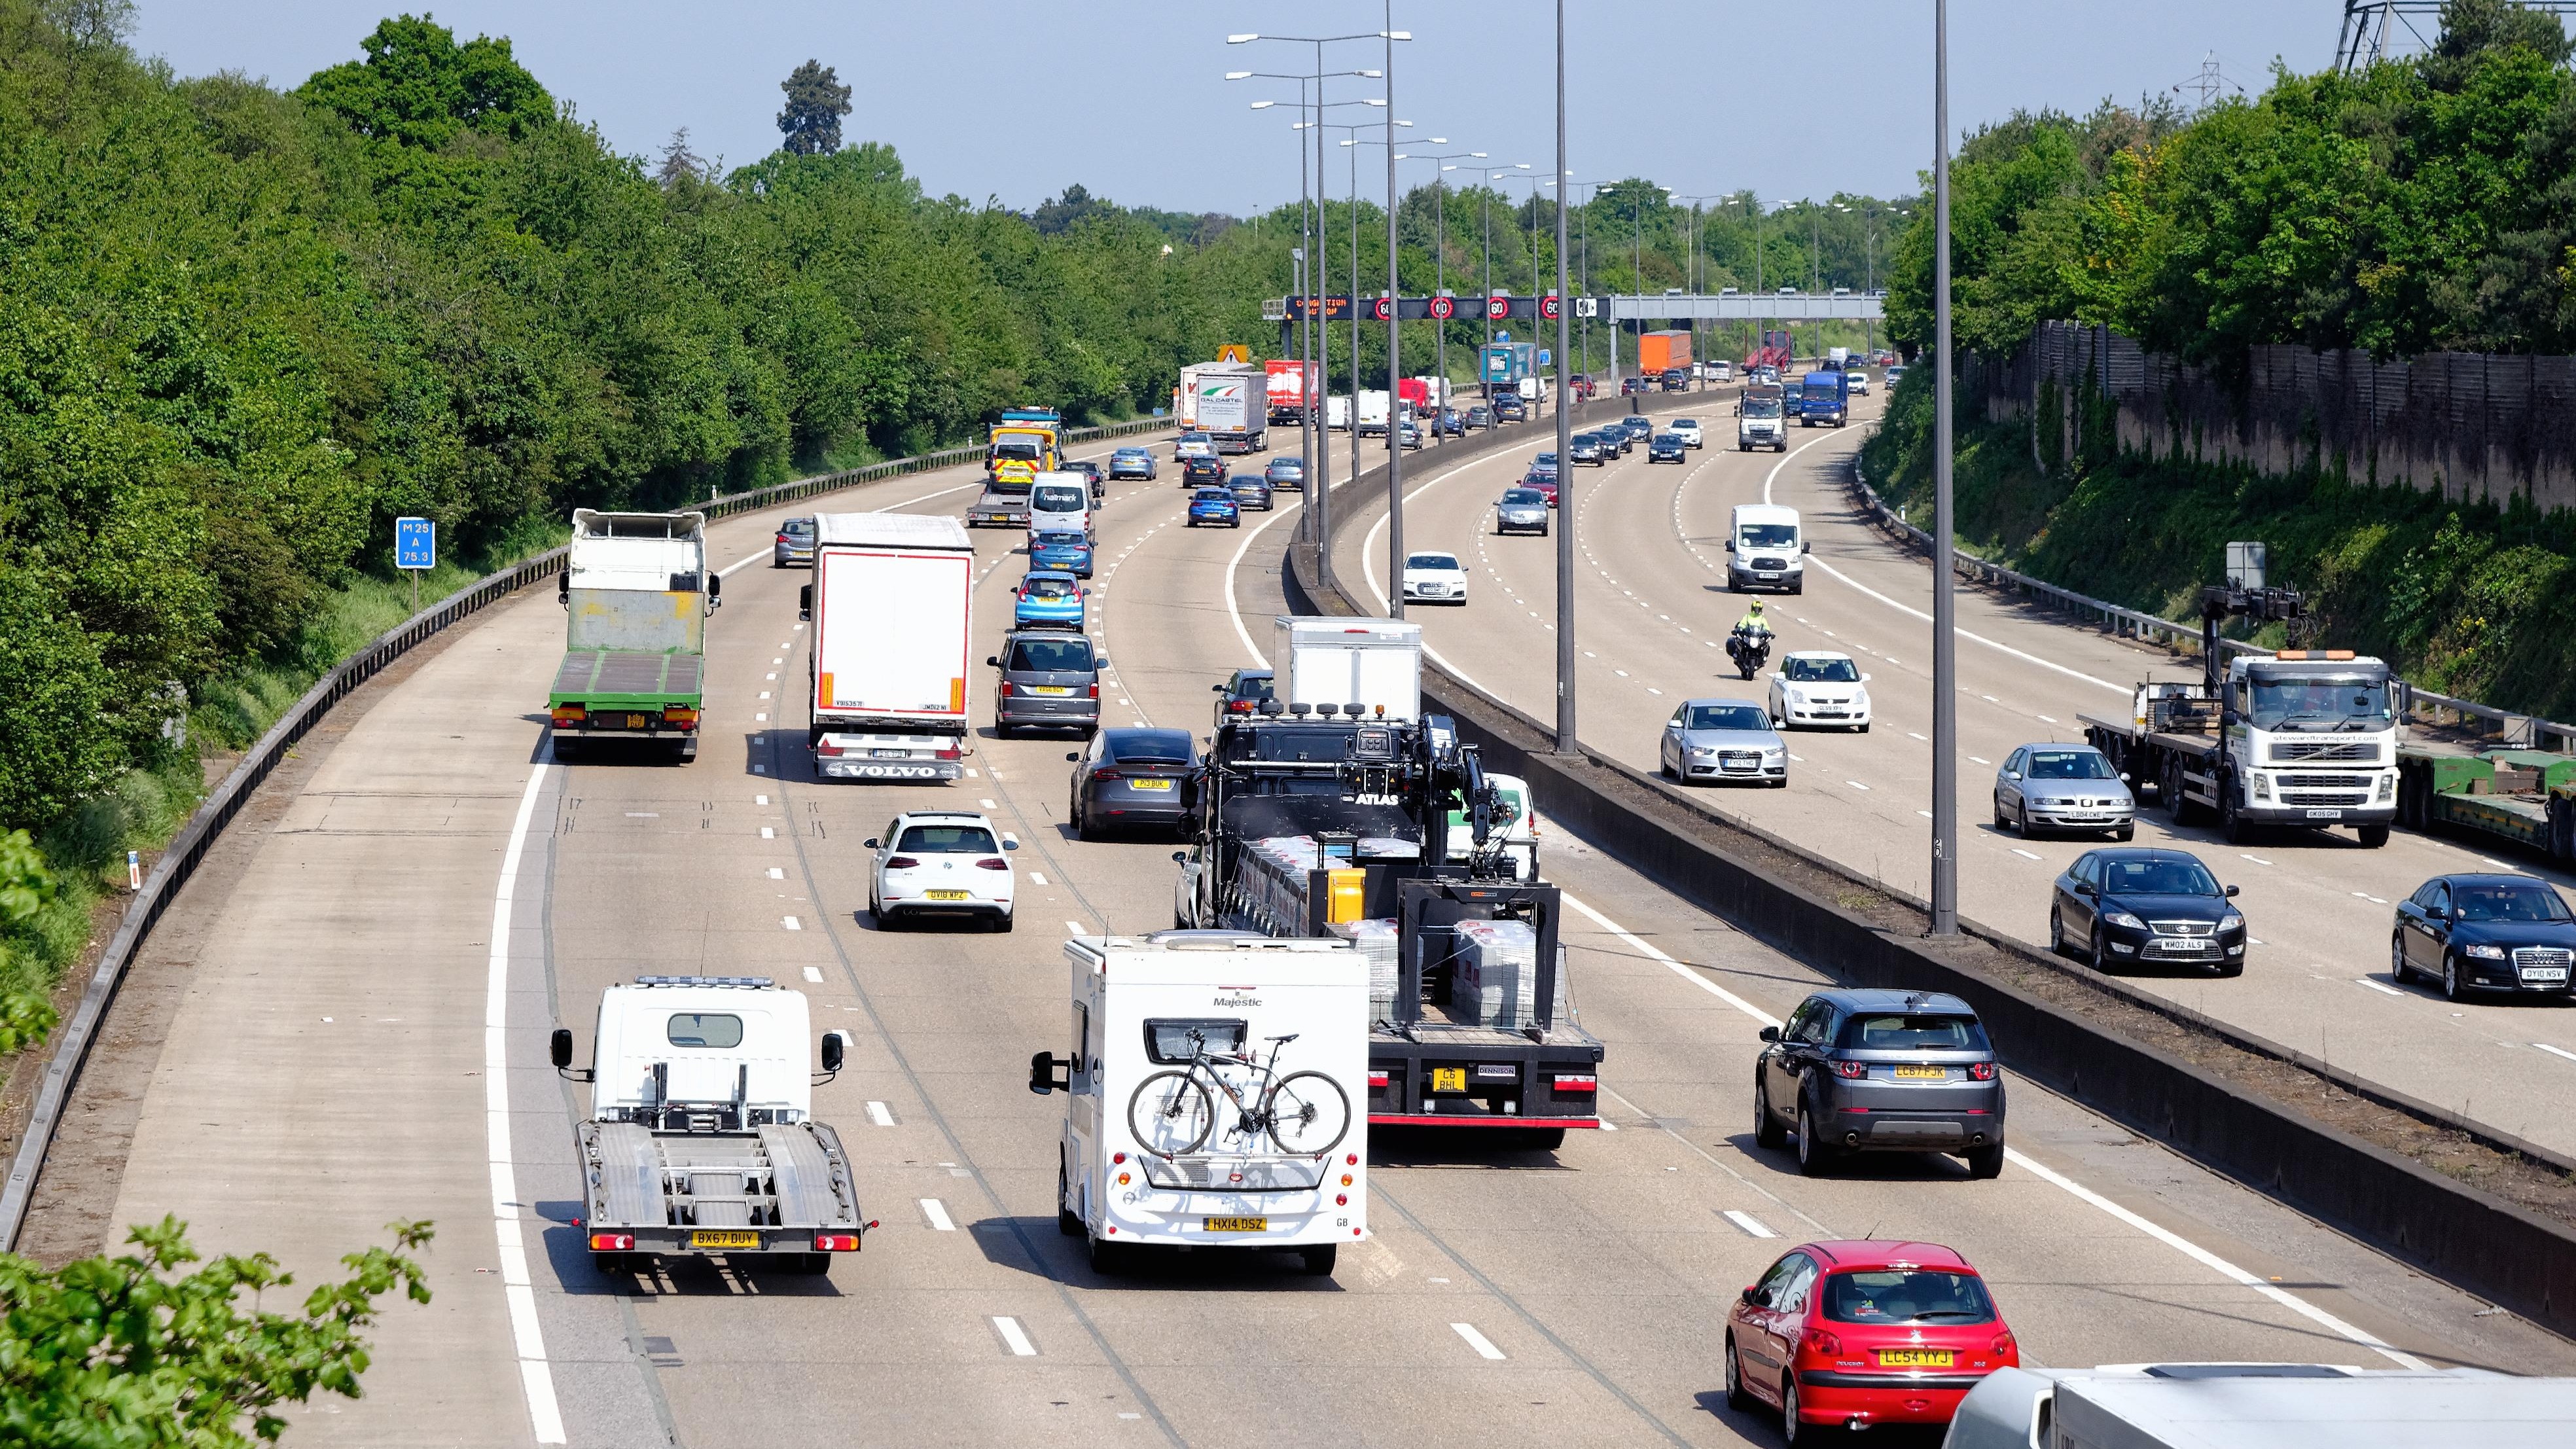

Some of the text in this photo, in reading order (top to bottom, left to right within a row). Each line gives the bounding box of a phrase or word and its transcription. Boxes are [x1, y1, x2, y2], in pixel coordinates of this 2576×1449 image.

[1491, 303, 1503, 314] 60
[412, 537, 420, 547] A
[845, 765, 936, 777] VOLVO
[1355, 794, 1399, 806] ATLAS
[1213, 997, 1262, 1009] Majestic
[1444, 1070, 1455, 1079] C6
[1897, 1066, 1921, 1075] LC67
[1440, 1081, 1458, 1090] BHL
[1213, 1219, 1238, 1229] HX14
[1242, 1219, 1262, 1229] DSZ
[1337, 1218, 1348, 1226] GB
[698, 1233, 753, 1243] BX67 DUY
[1885, 1351, 1948, 1363] LC54 YYJ
